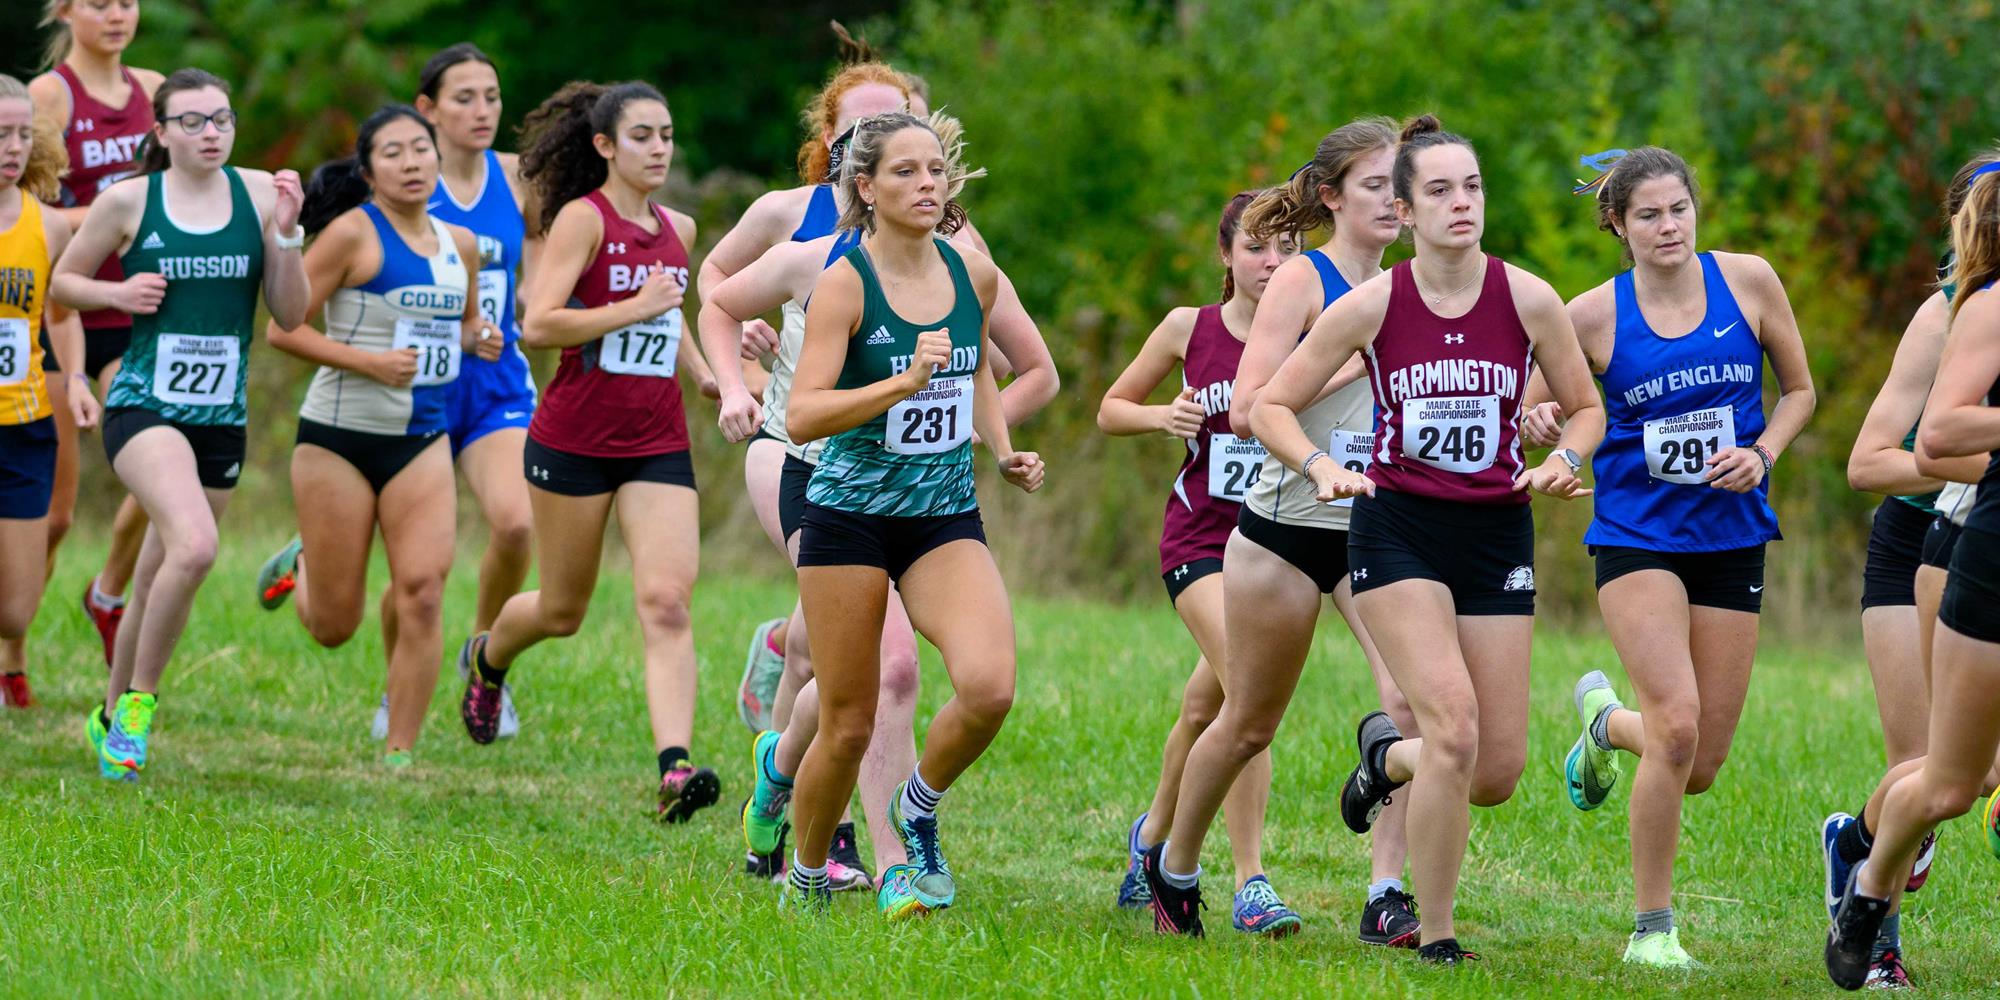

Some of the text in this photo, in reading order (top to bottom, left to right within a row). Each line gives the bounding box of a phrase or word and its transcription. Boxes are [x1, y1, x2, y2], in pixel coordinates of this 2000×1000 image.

[158, 255, 249, 280] HUSSON
[401, 291, 465, 312] COLBY
[618, 330, 668, 365] 172
[866, 335, 896, 345] adidas
[407, 344, 450, 377] 18
[168, 362, 227, 394] 227
[937, 380, 956, 391] STATE
[1389, 359, 1518, 404] FARMINGTON
[1623, 364, 1754, 407] NEW ENGLAND
[1419, 409, 1487, 420] CHAMPIONSHIPS
[1426, 400, 1480, 410] MAINE STATE
[1665, 411, 1717, 425] MAINE STATE
[901, 405, 958, 444] 231
[1659, 419, 1723, 435] CHAMPIONSHIPS
[1418, 425, 1486, 462] 246
[1660, 436, 1719, 475] 291
